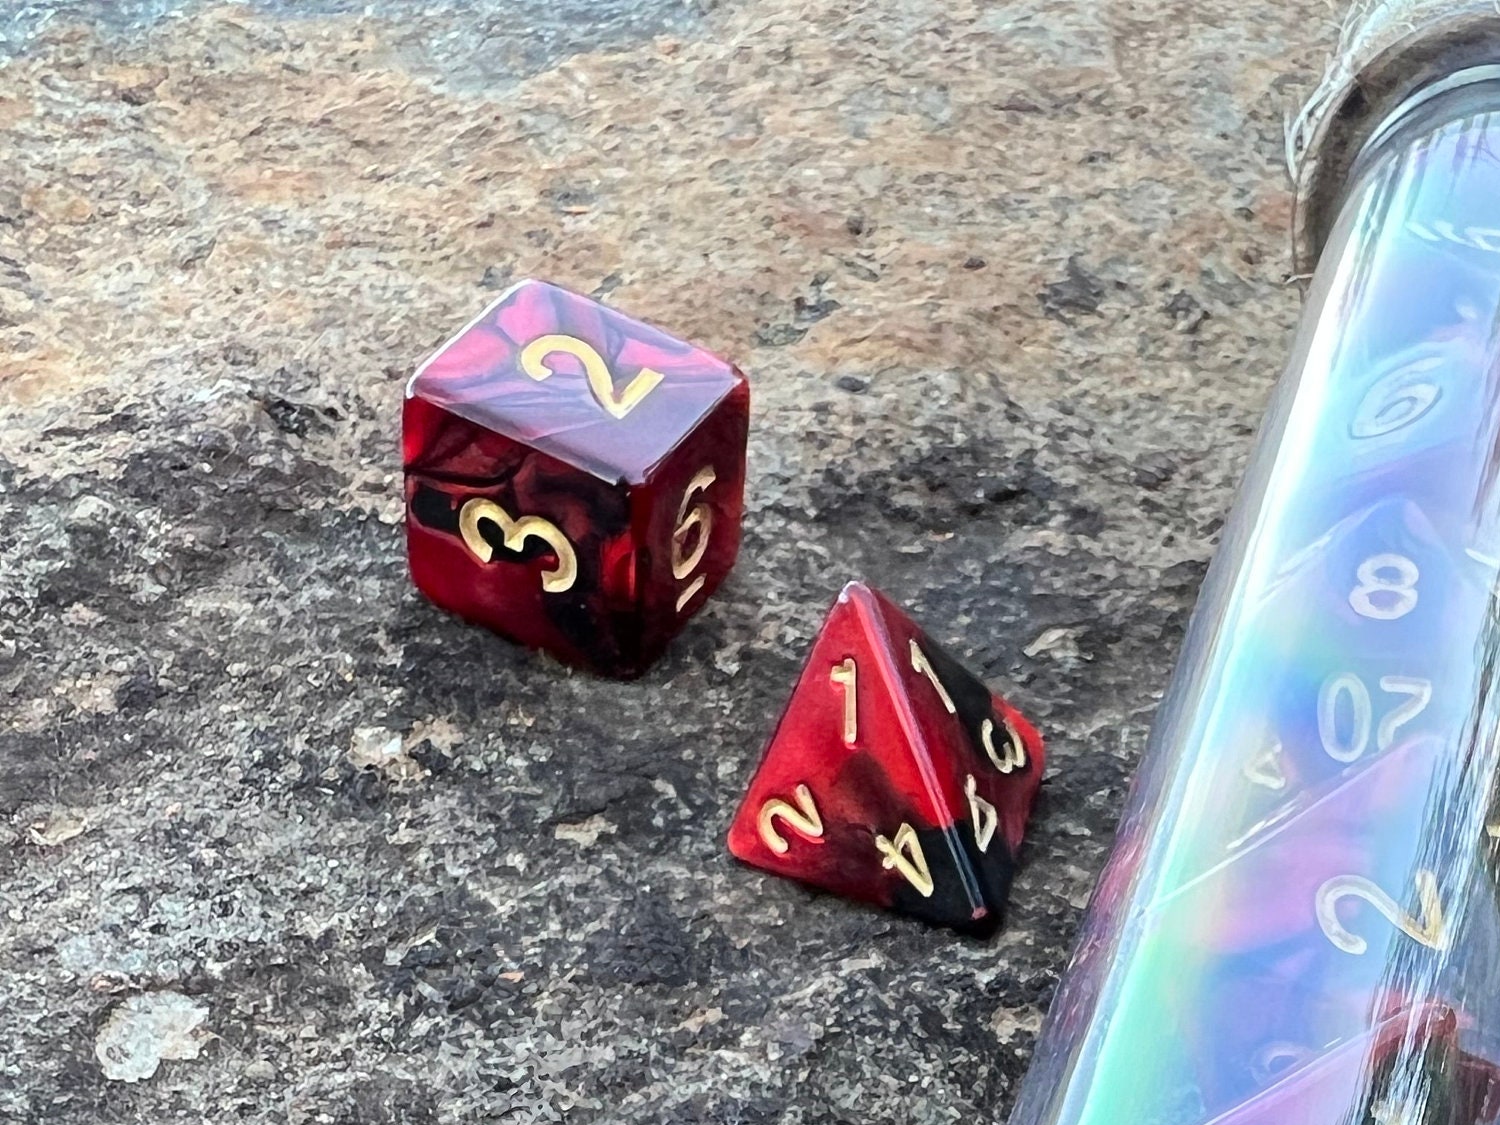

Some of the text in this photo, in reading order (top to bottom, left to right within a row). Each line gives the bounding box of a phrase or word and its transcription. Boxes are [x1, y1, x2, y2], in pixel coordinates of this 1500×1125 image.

[521, 334, 665, 420] 2
[458, 496, 578, 593] 3
[1349, 552, 1420, 621] 8
[829, 657, 859, 749] 1
[908, 638, 957, 714] 1
[980, 717, 1026, 775] 3
[755, 783, 825, 855] 2
[964, 772, 999, 854] 4
[874, 822, 935, 898] 4
[1315, 868, 1446, 956] 2
